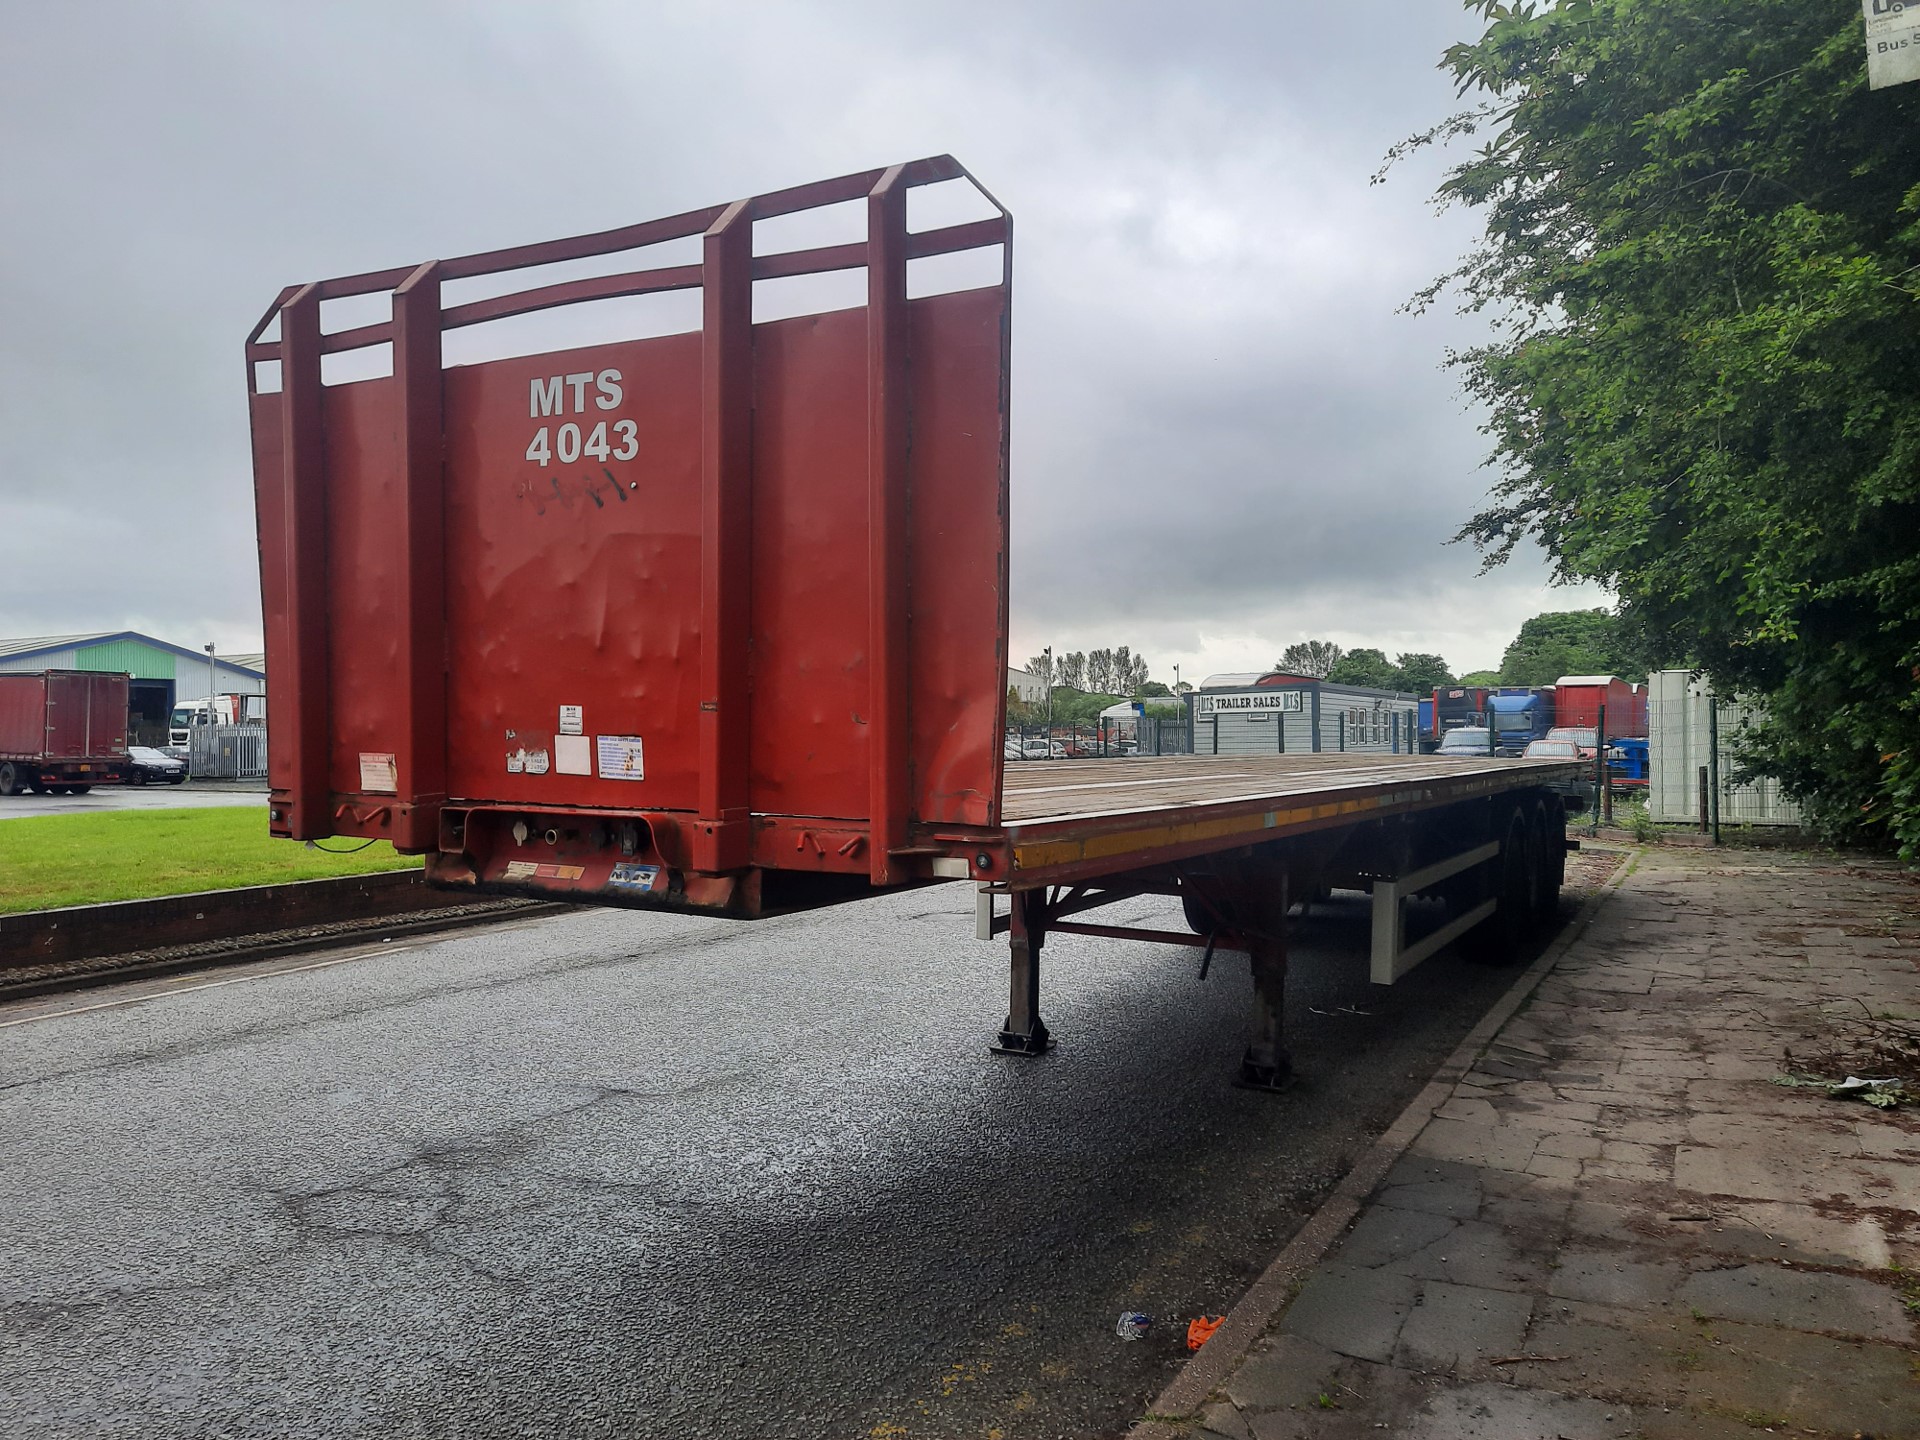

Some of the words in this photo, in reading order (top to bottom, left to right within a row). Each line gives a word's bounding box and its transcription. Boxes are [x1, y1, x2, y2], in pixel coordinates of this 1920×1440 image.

[1877, 39, 1908, 53] Bus
[530, 368, 623, 418] MTS
[525, 419, 639, 467] 4043
[1216, 697, 1251, 709] TRAILER
[1253, 696, 1280, 707] SALES
